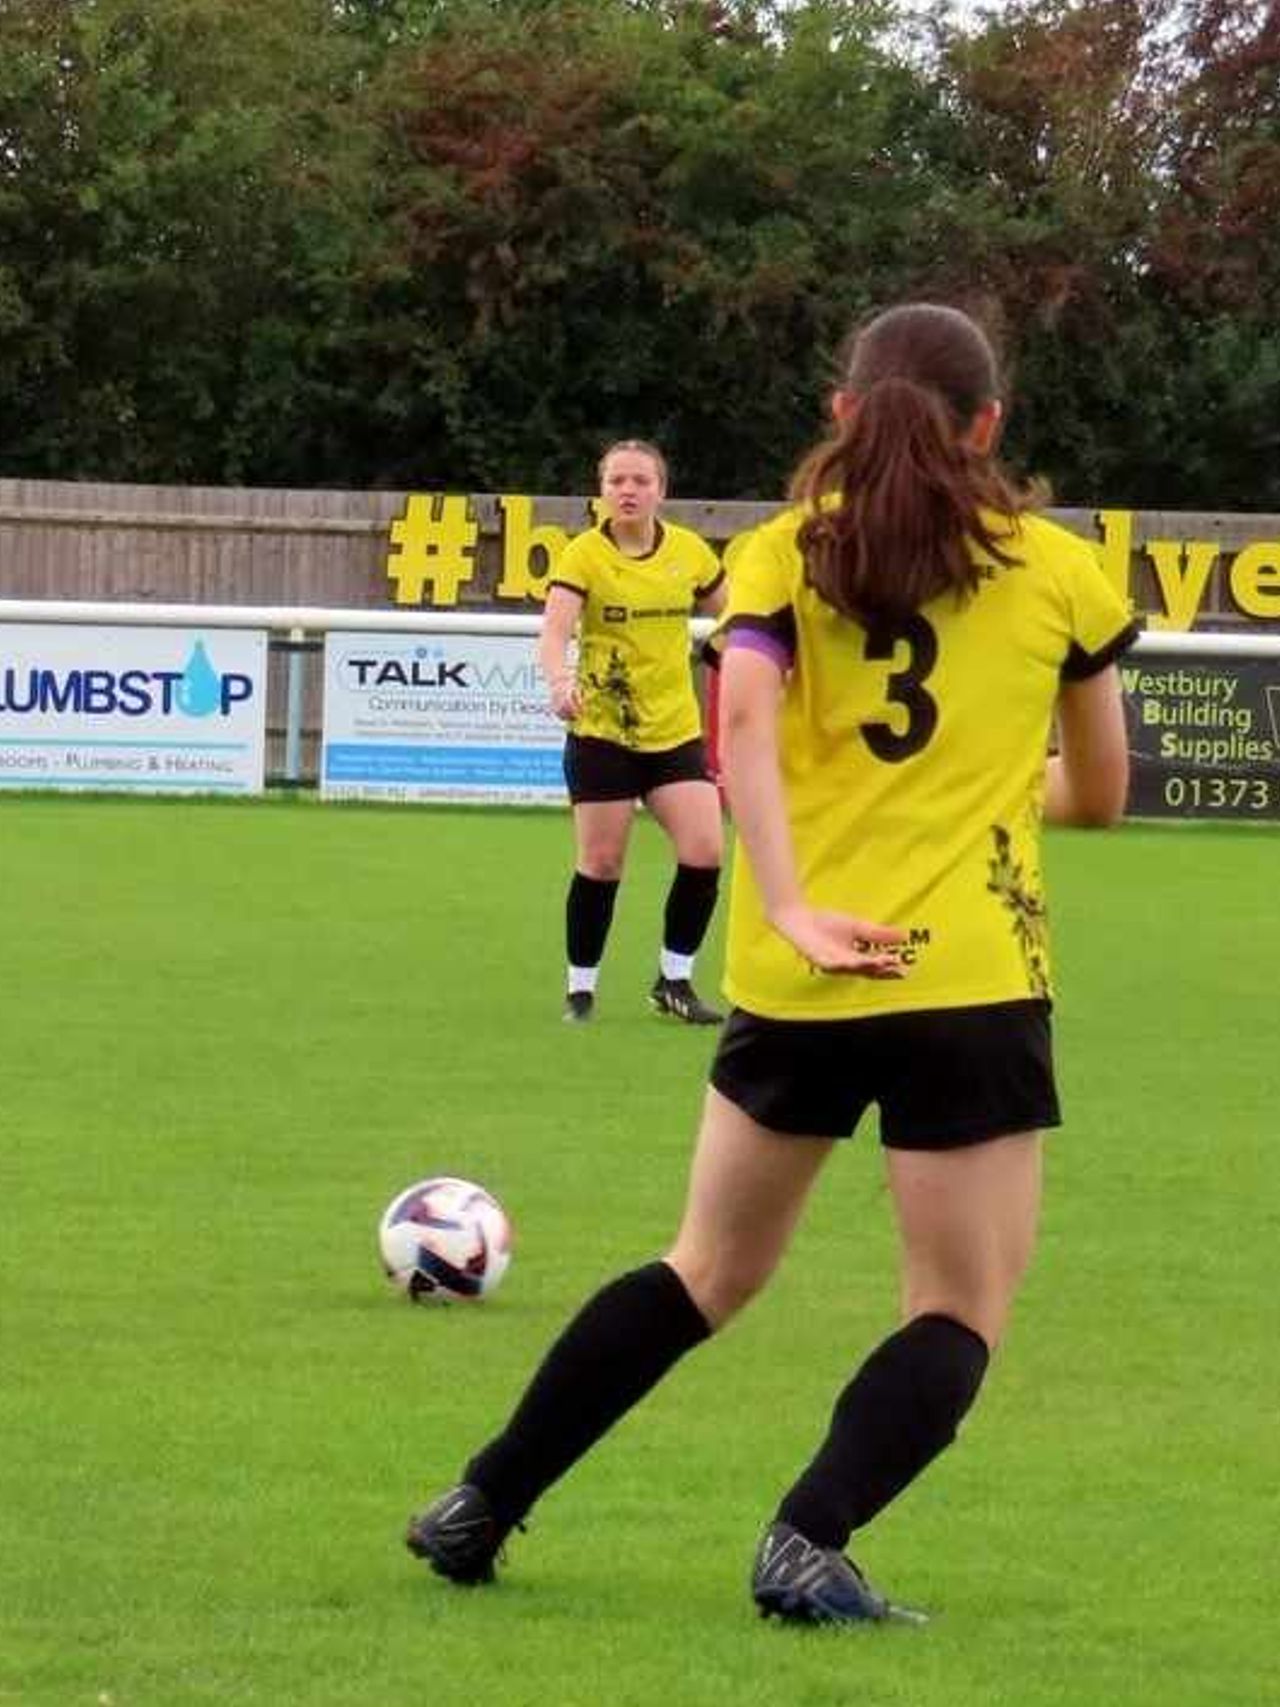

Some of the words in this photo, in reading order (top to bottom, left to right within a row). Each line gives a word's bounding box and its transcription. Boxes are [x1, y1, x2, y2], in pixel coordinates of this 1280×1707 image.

[860, 606, 940, 764] 3
[369, 692, 485, 712] Communication
[489, 697, 507, 716] by
[1143, 700, 1252, 733] Building
[148, 753, 159, 771] &
[1160, 732, 1274, 764] Supplies
[1165, 777, 1270, 810] 01373
